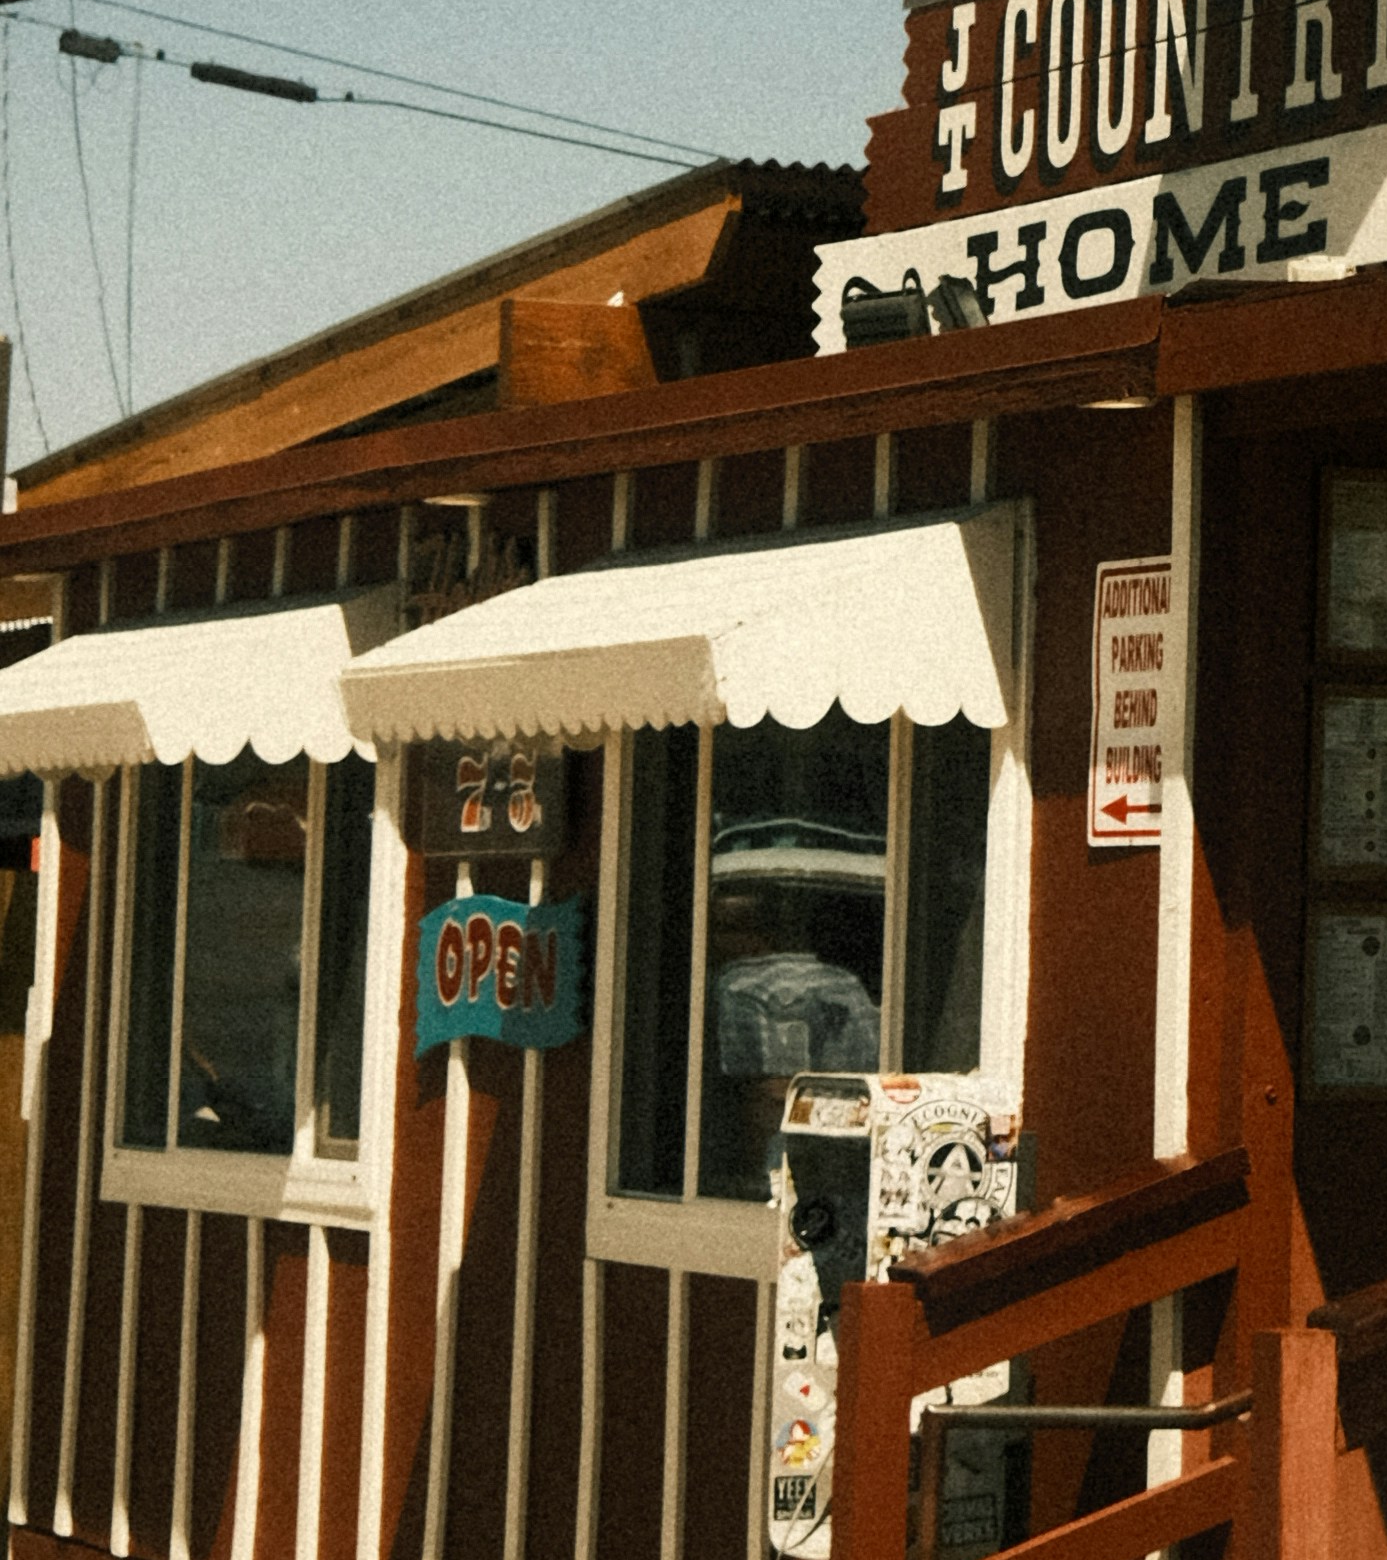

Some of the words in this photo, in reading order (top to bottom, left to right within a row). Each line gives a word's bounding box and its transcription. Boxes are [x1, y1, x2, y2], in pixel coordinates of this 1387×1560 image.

[967, 156, 1331, 317] HOME
[1112, 633, 1164, 672] PARKING
[1114, 689, 1157, 728] BEHIND
[1106, 745, 1161, 783] BUILDING
[435, 912, 558, 1012] OPEN
